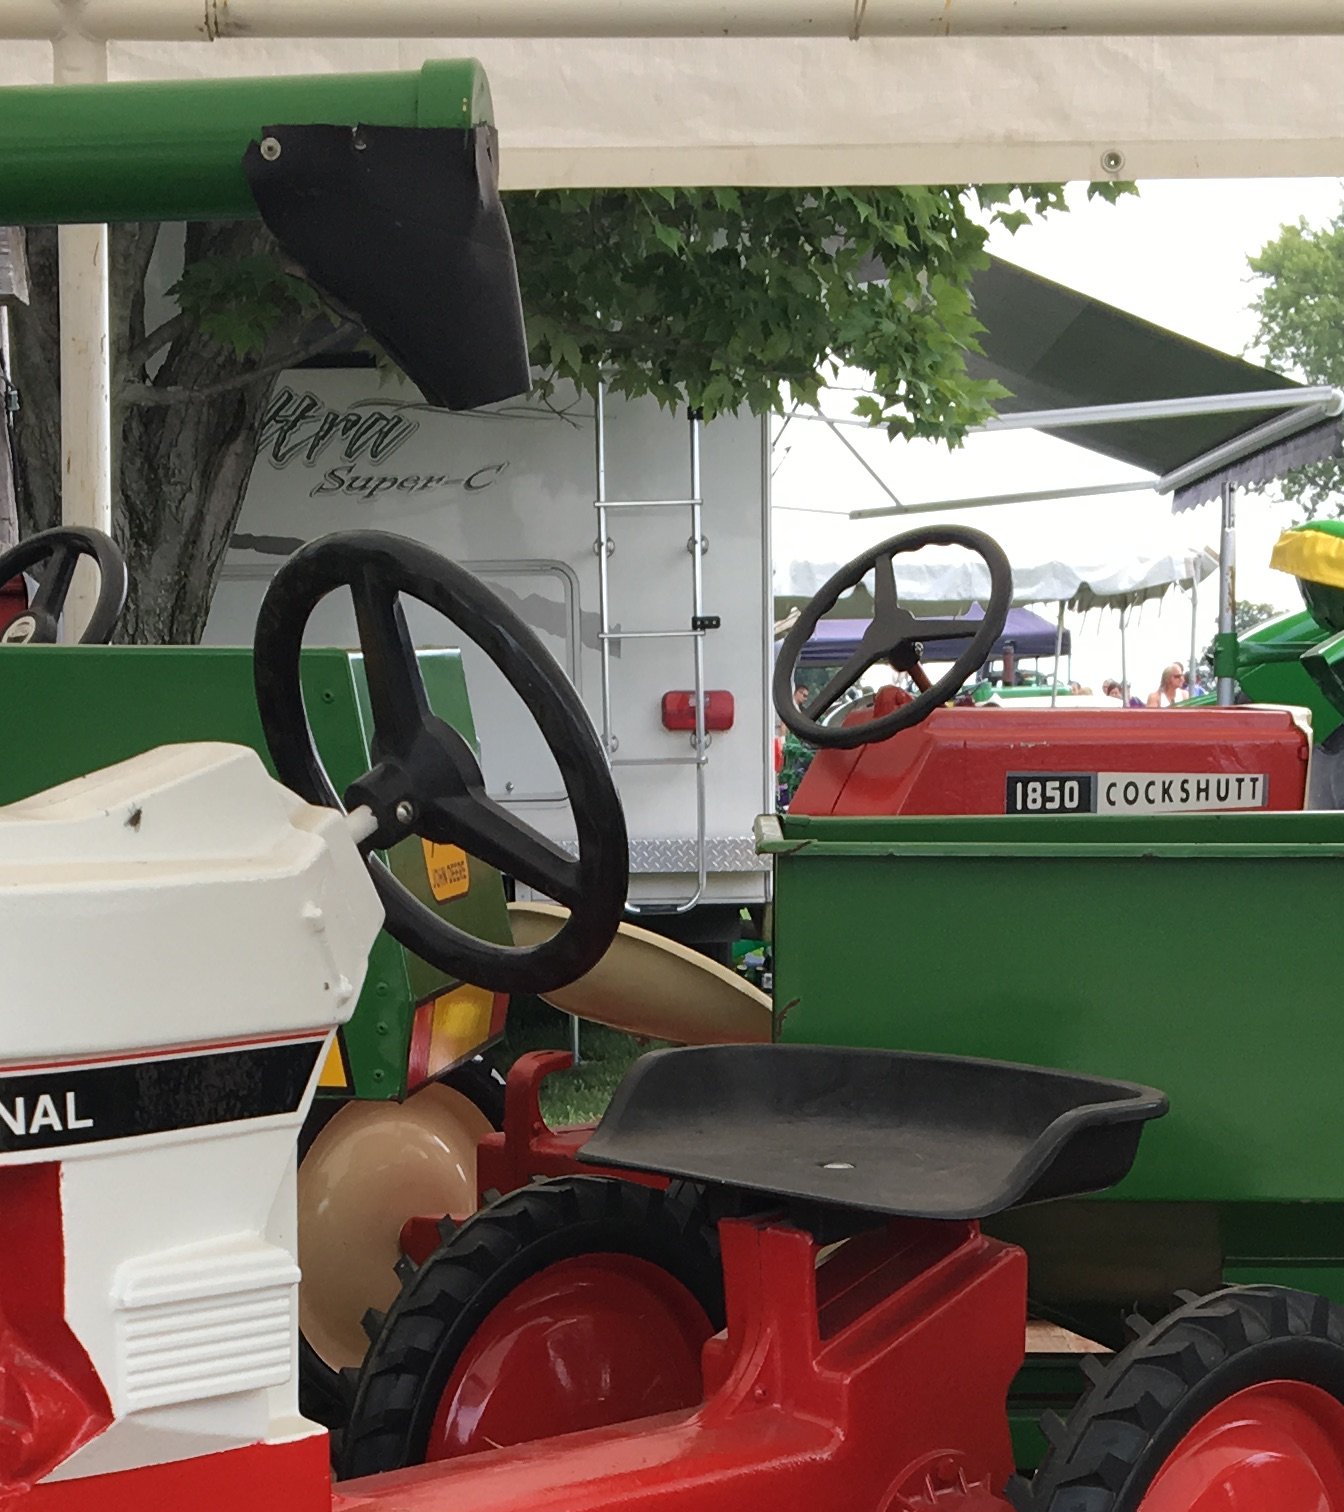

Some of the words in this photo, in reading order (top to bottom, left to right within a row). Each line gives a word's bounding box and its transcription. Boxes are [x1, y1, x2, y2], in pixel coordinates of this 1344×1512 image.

[310, 461, 509, 501] Super-C
[1016, 779, 1081, 811] 1850
[1106, 777, 1260, 806] COCKSHUTT
